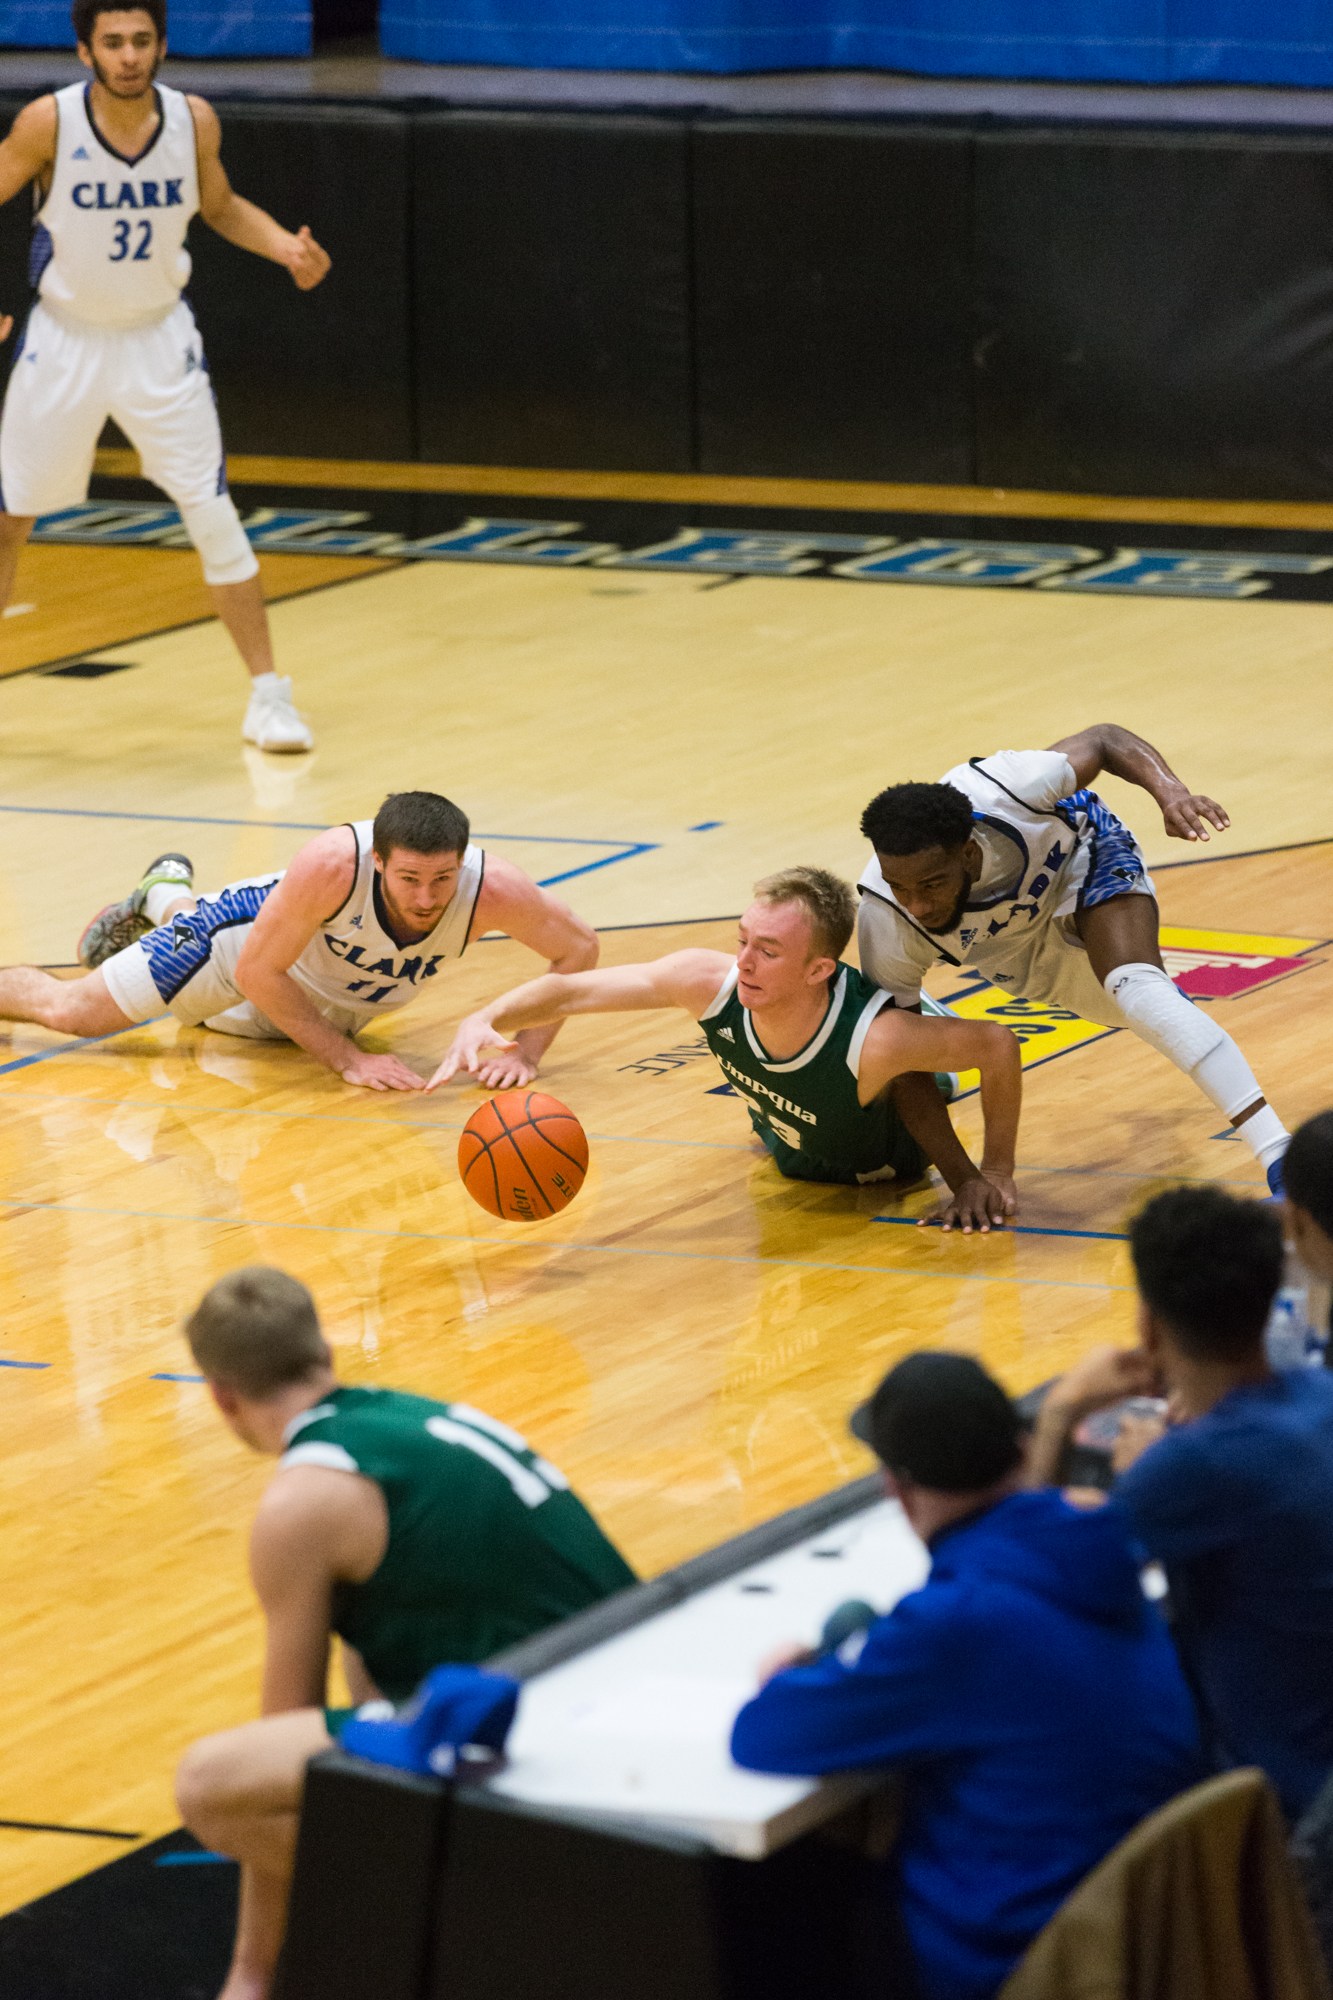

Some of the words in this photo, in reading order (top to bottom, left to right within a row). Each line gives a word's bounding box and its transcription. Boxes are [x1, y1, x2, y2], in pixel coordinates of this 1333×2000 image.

[71, 177, 184, 210] CLARK
[108, 219, 154, 262] 32
[27, 499, 1333, 598] OLLEGE
[324, 933, 446, 986] CLARK
[616, 1035, 709, 1077] ANCE
[716, 1053, 818, 1127] Umpqua
